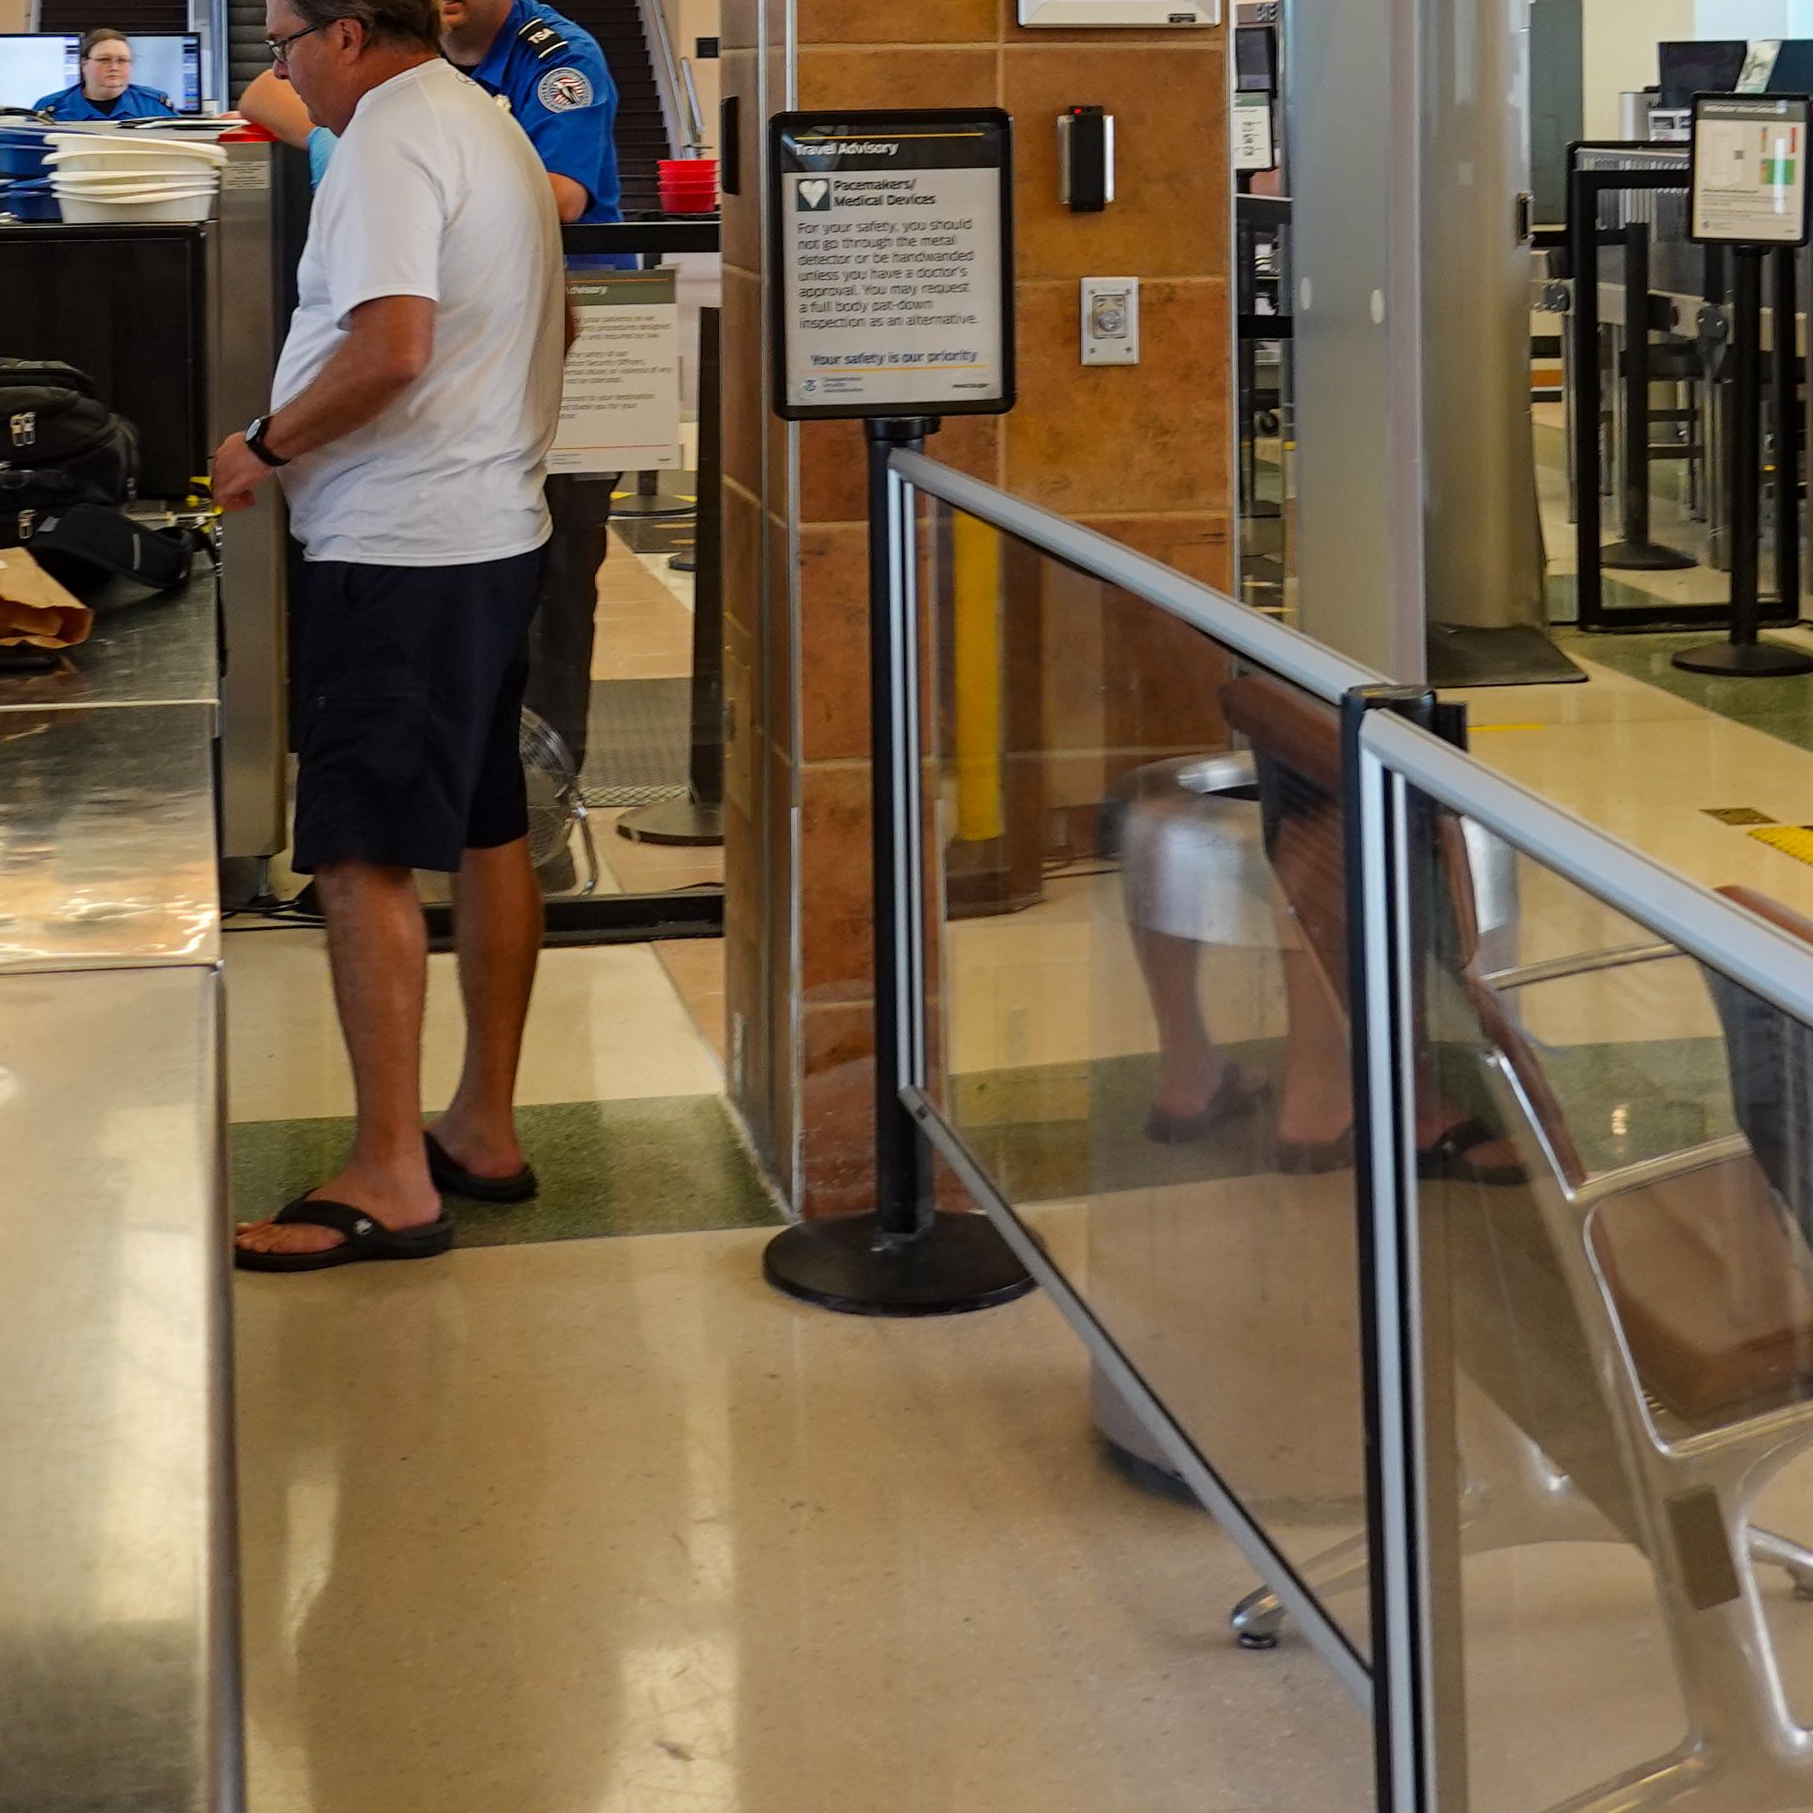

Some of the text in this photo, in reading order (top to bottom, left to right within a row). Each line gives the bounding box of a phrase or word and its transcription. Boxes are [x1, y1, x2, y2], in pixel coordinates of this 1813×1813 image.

[528, 28, 555, 43] TSA
[795, 142, 899, 156] Travel Advisory
[834, 193, 935, 206] Medical Devices
[798, 223, 818, 234] For
[902, 221, 927, 233] you
[844, 352, 884, 365] safety
